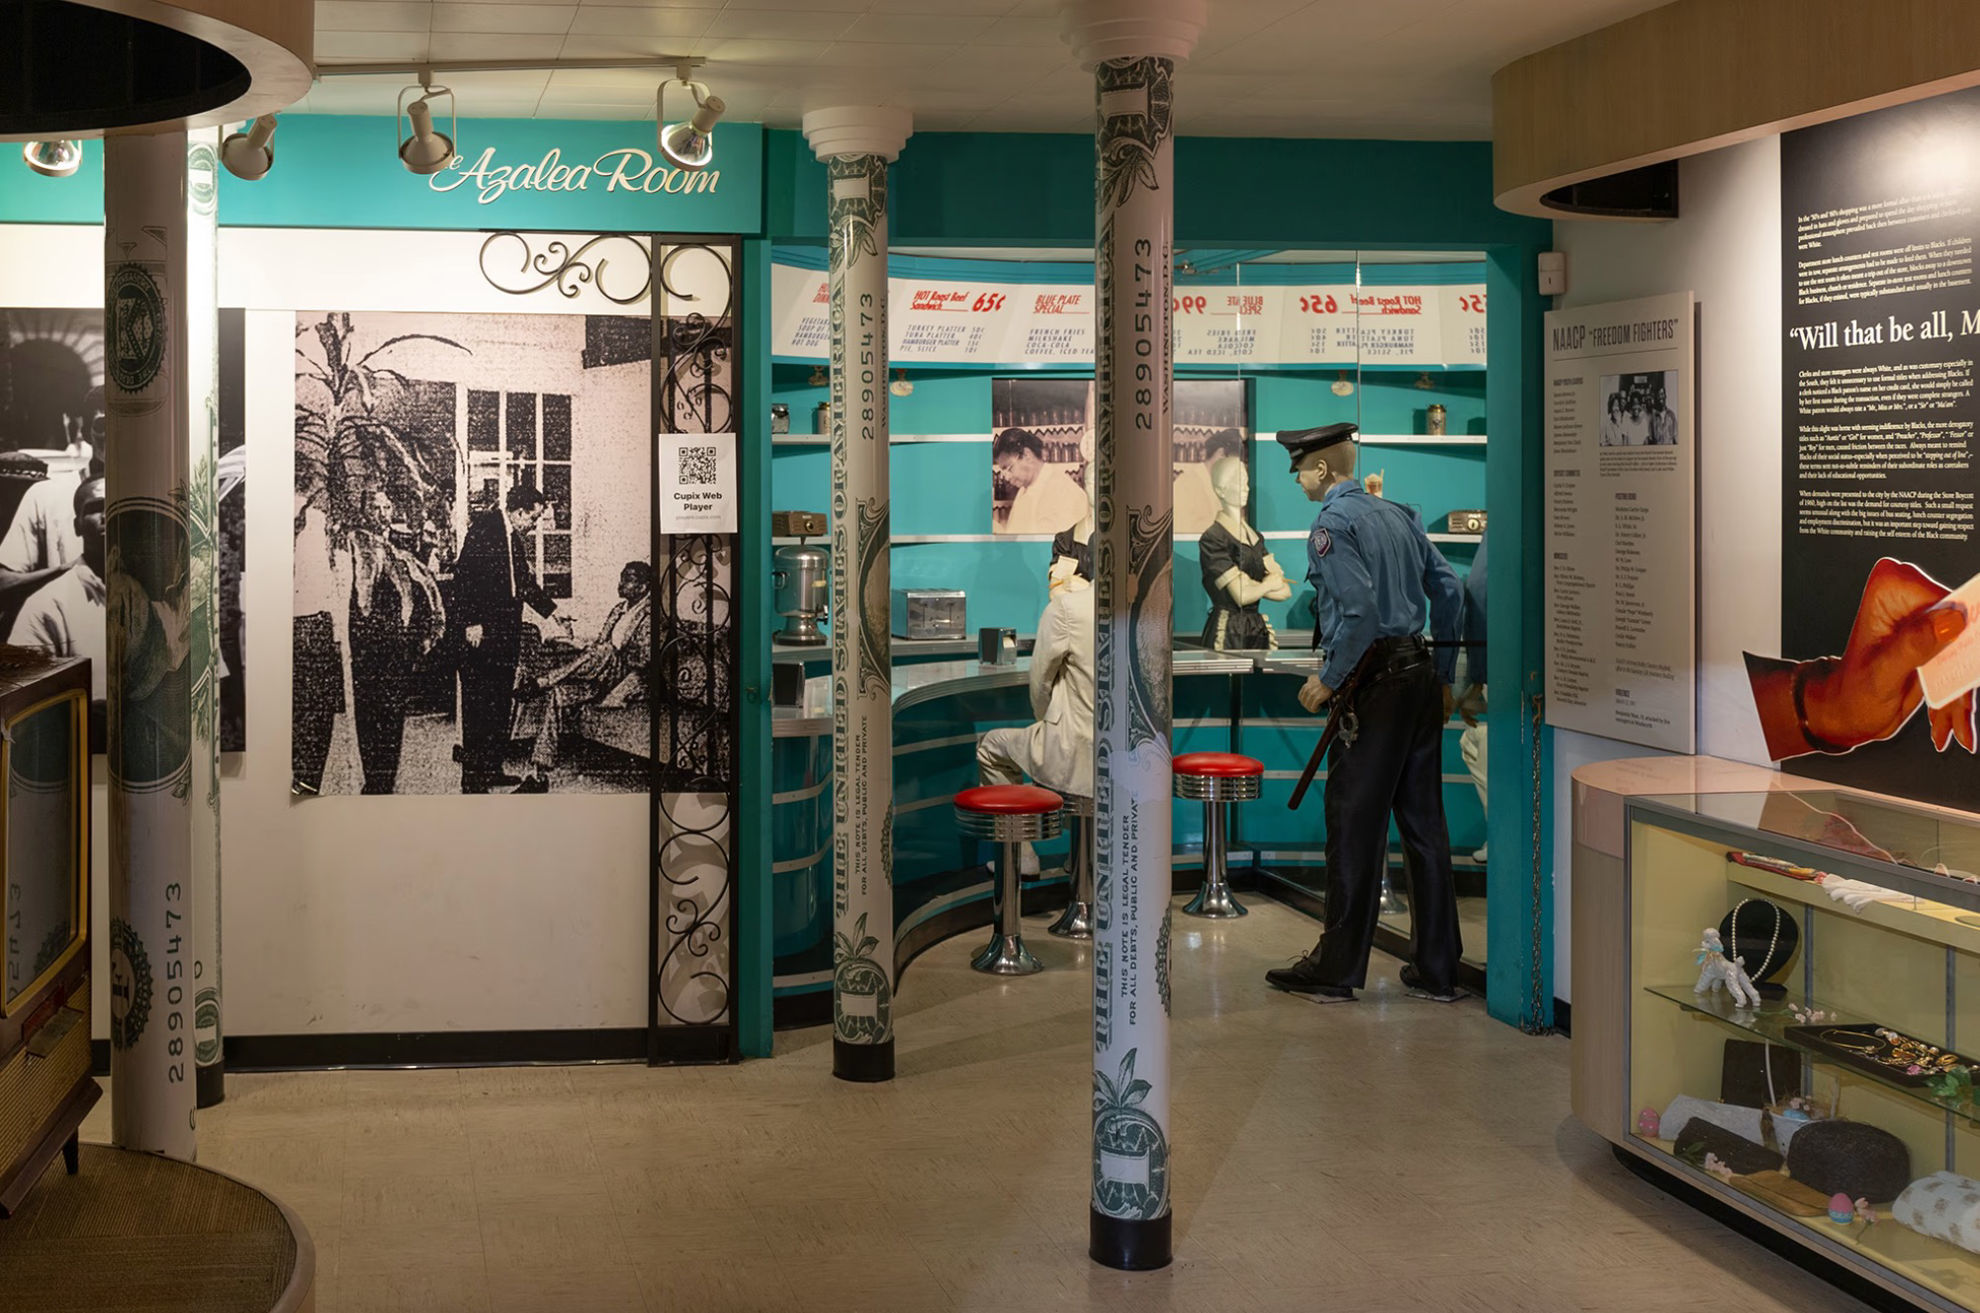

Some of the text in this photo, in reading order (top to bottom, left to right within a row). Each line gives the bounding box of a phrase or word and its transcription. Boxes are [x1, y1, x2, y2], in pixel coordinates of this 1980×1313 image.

[429, 147, 720, 205] Azalea Room
[911, 300, 943, 310] Sandwich
[914, 290, 970, 302] HOT Roast Beef
[1034, 304, 1064, 313] SPECIAL
[1035, 294, 1081, 305] BLUE PLATE
[1135, 238, 1152, 430] 28905473
[1553, 325, 1586, 351] NAACP
[1844, 319, 1884, 347] that
[1888, 315, 1914, 342] be
[1920, 310, 1953, 343] all,
[830, 272, 847, 466] AMERICA
[860, 293, 874, 440] 28905473
[674, 492, 723, 501] Cupix Web
[683, 503, 713, 511] Player
[831, 471, 847, 519] OF
[834, 522, 849, 671] STATES
[1097, 539, 1115, 731] STATES
[835, 676, 849, 823] UNITED
[1095, 738, 1113, 931] UNITED
[1129, 845, 1138, 872] AND
[1121, 815, 1129, 997] THIS NOTE IS LEGAL TENDER
[1129, 876, 1138, 920] PUBLIC
[1129, 924, 1139, 970] DEBTS,
[165, 882, 184, 1083] 28905473
[1129, 974, 1138, 997] ALL
[1129, 1001, 1138, 1025] FOR
